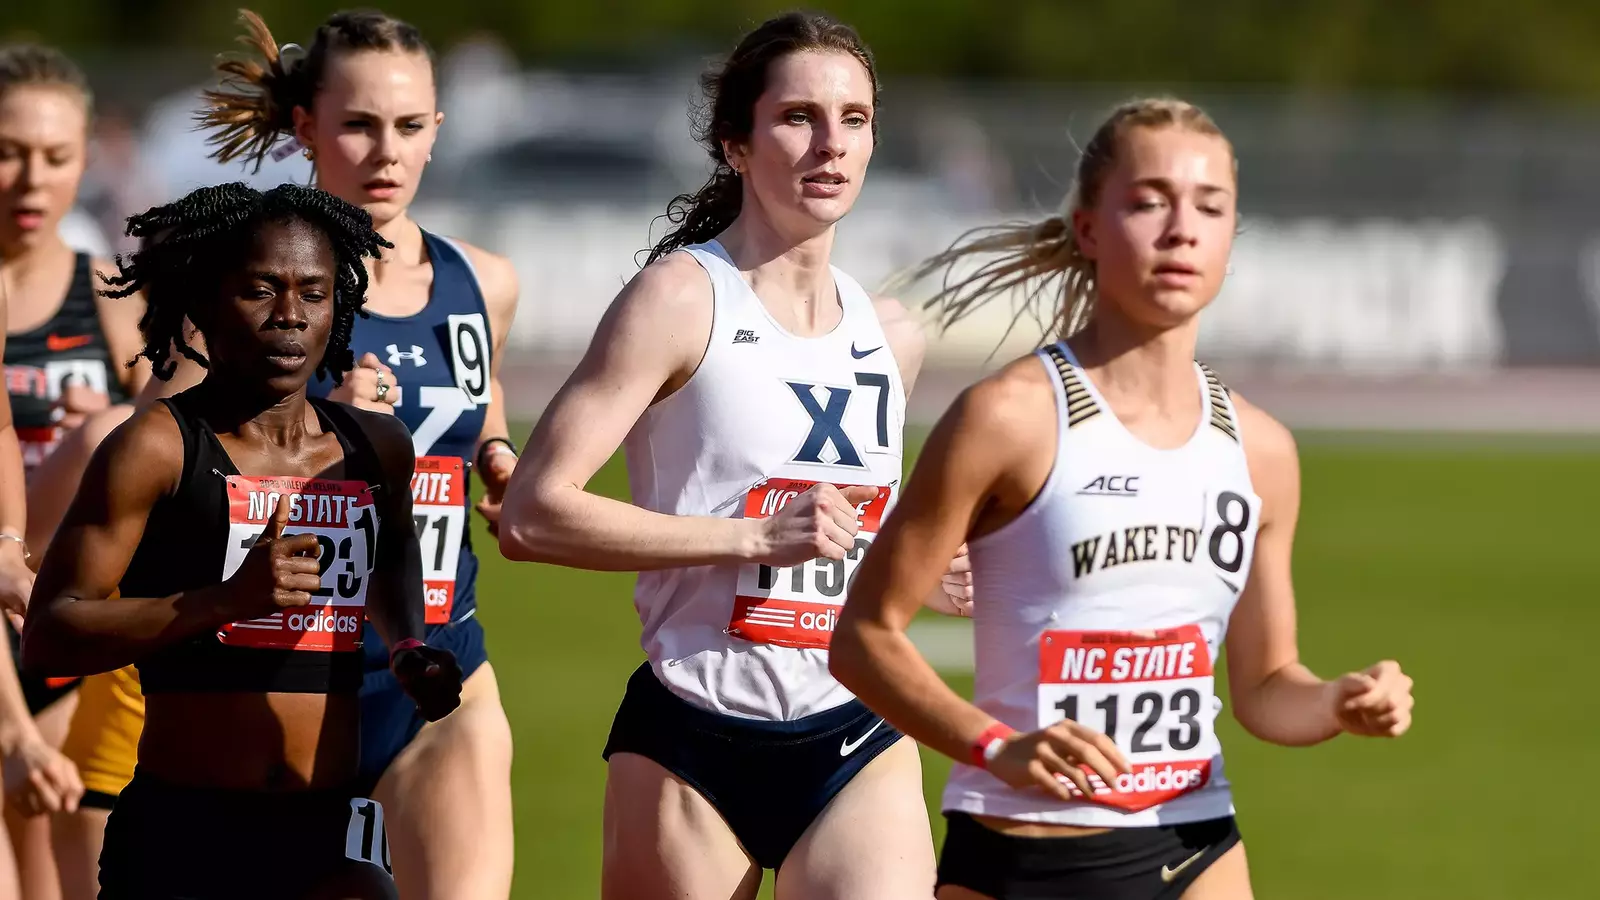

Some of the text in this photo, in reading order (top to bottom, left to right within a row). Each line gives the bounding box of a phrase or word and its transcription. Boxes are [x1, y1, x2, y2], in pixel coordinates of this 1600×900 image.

[457, 322, 485, 397] 9
[783, 380, 865, 467] X
[854, 372, 889, 447] 7
[410, 472, 452, 503] ATE
[1083, 476, 1139, 492] ACC
[1209, 491, 1250, 573] 8
[1071, 525, 1202, 579] WAKE FO
[288, 613, 357, 632] adidas
[800, 610, 838, 632] adi
[1061, 643, 1195, 680] NC STATE
[1116, 766, 1201, 793] adidas
